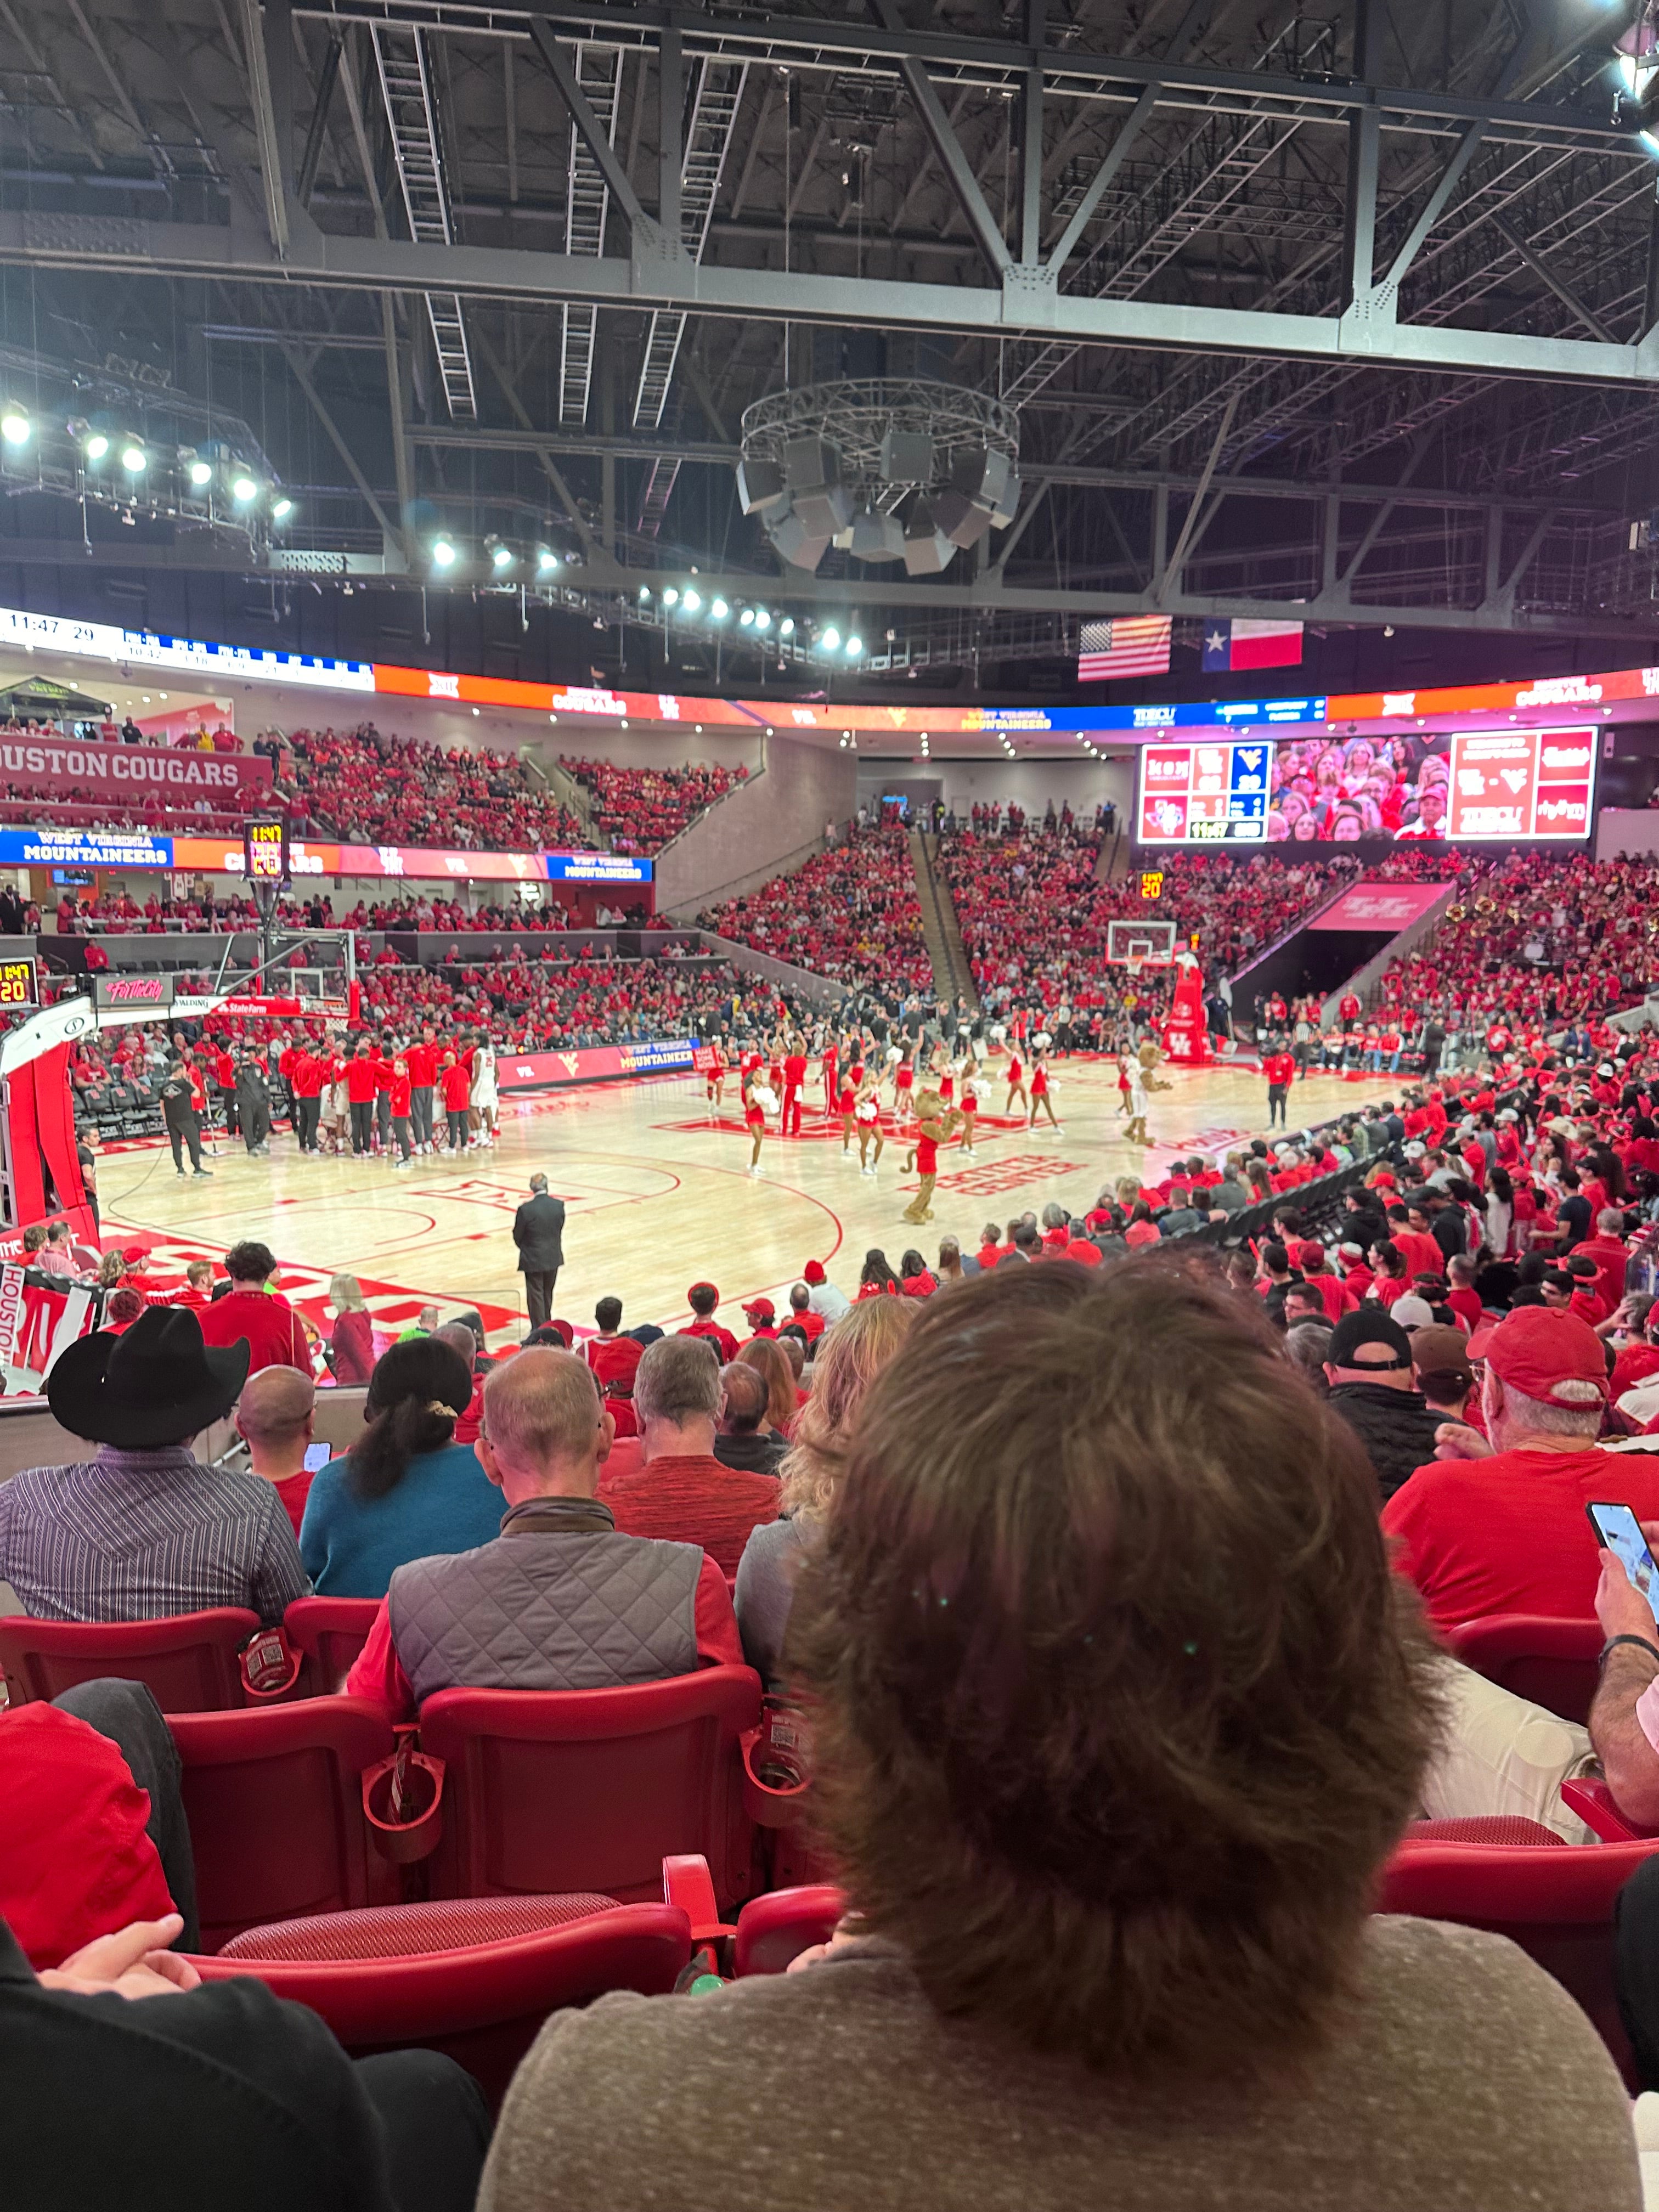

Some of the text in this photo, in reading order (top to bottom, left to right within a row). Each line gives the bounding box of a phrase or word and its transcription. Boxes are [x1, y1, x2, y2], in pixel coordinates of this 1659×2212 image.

[10, 614, 93, 641] 11:47 29
[0, 744, 238, 787] USTON COUGARS
[38, 831, 153, 848] WEST VIRGINIA
[252, 825, 282, 843] 11:47
[24, 845, 167, 864] MOUNTAINEERS
[253, 844, 279, 875] 20
[1141, 882, 1161, 899] 20
[1, 980, 25, 1002] 20
